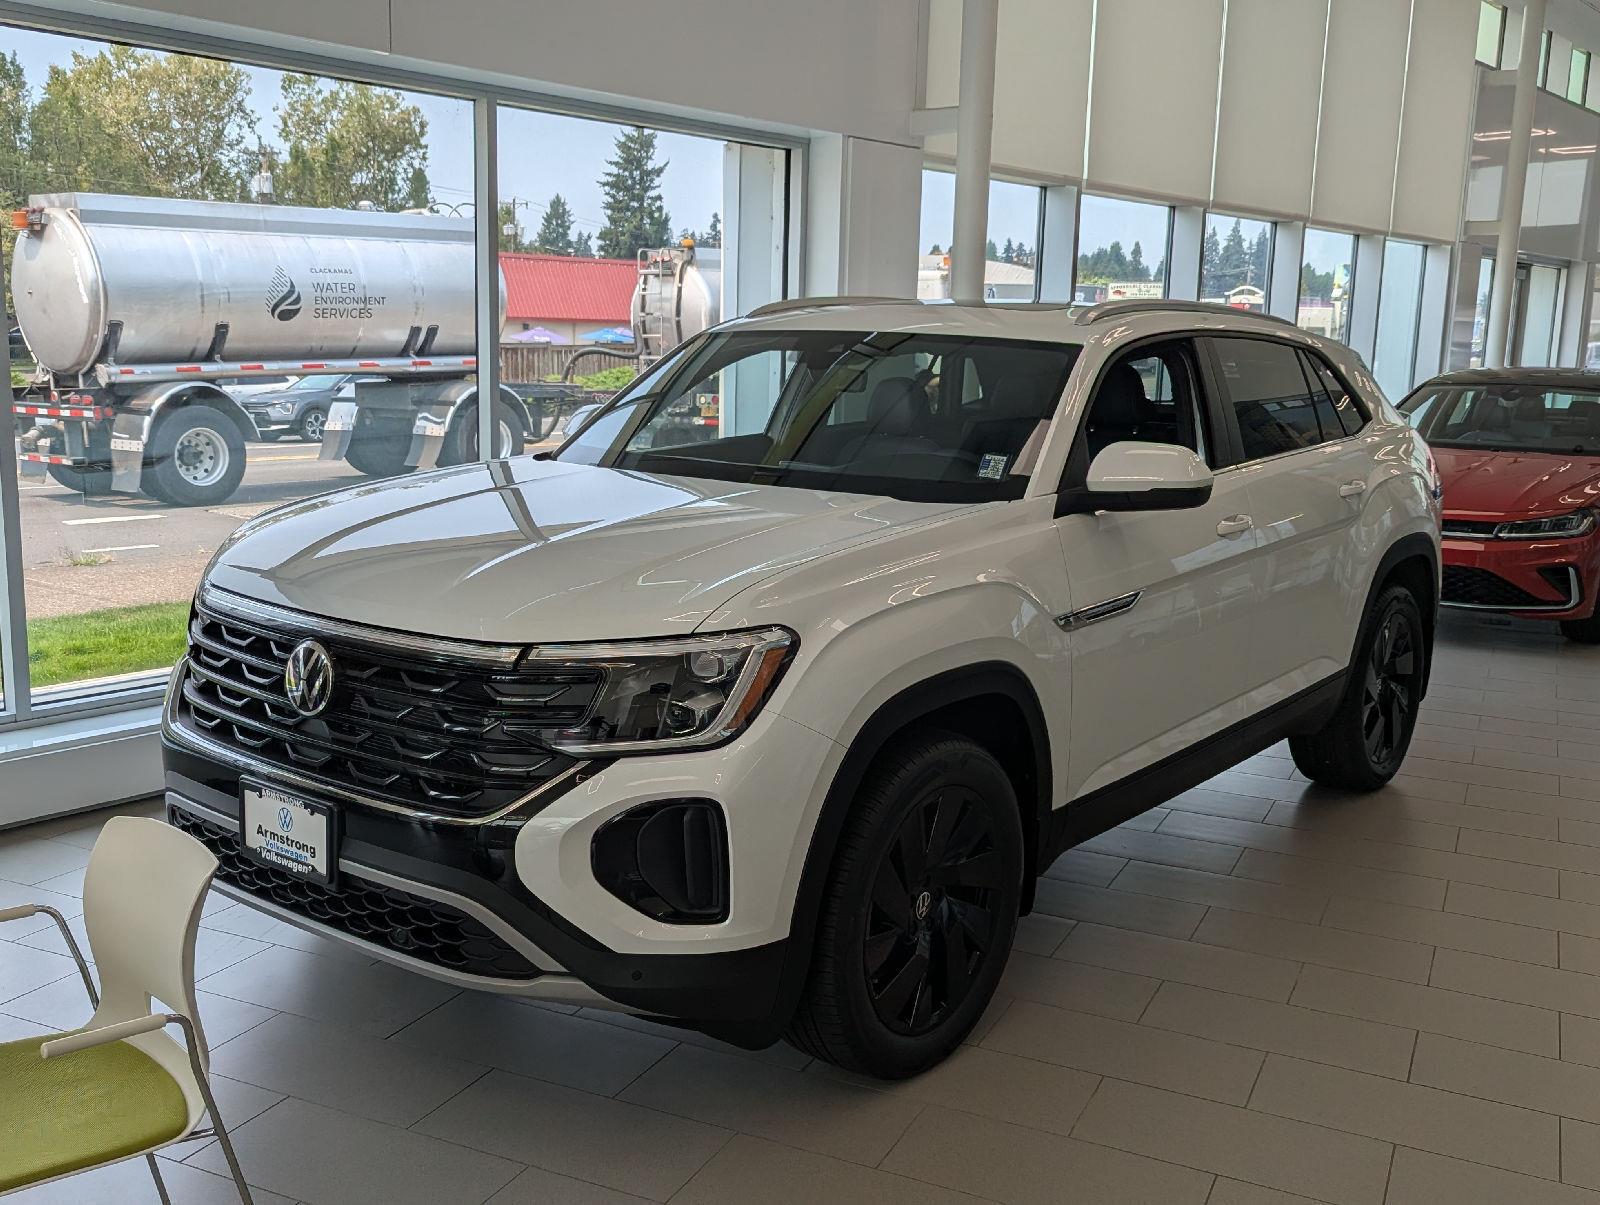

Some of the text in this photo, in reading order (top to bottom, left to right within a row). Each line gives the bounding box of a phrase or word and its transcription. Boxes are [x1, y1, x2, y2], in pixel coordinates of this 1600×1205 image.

[310, 267, 353, 275] CLACKAMAS
[312, 282, 356, 294] WATER
[314, 296, 386, 305] ENVIRONMENT
[313, 307, 373, 319] SERVICES
[261, 788, 305, 809] ARMSTRONG
[256, 823, 316, 858] Armstrong
[264, 839, 308, 862] Volkswagen
[261, 847, 308, 874] Volkswagen
